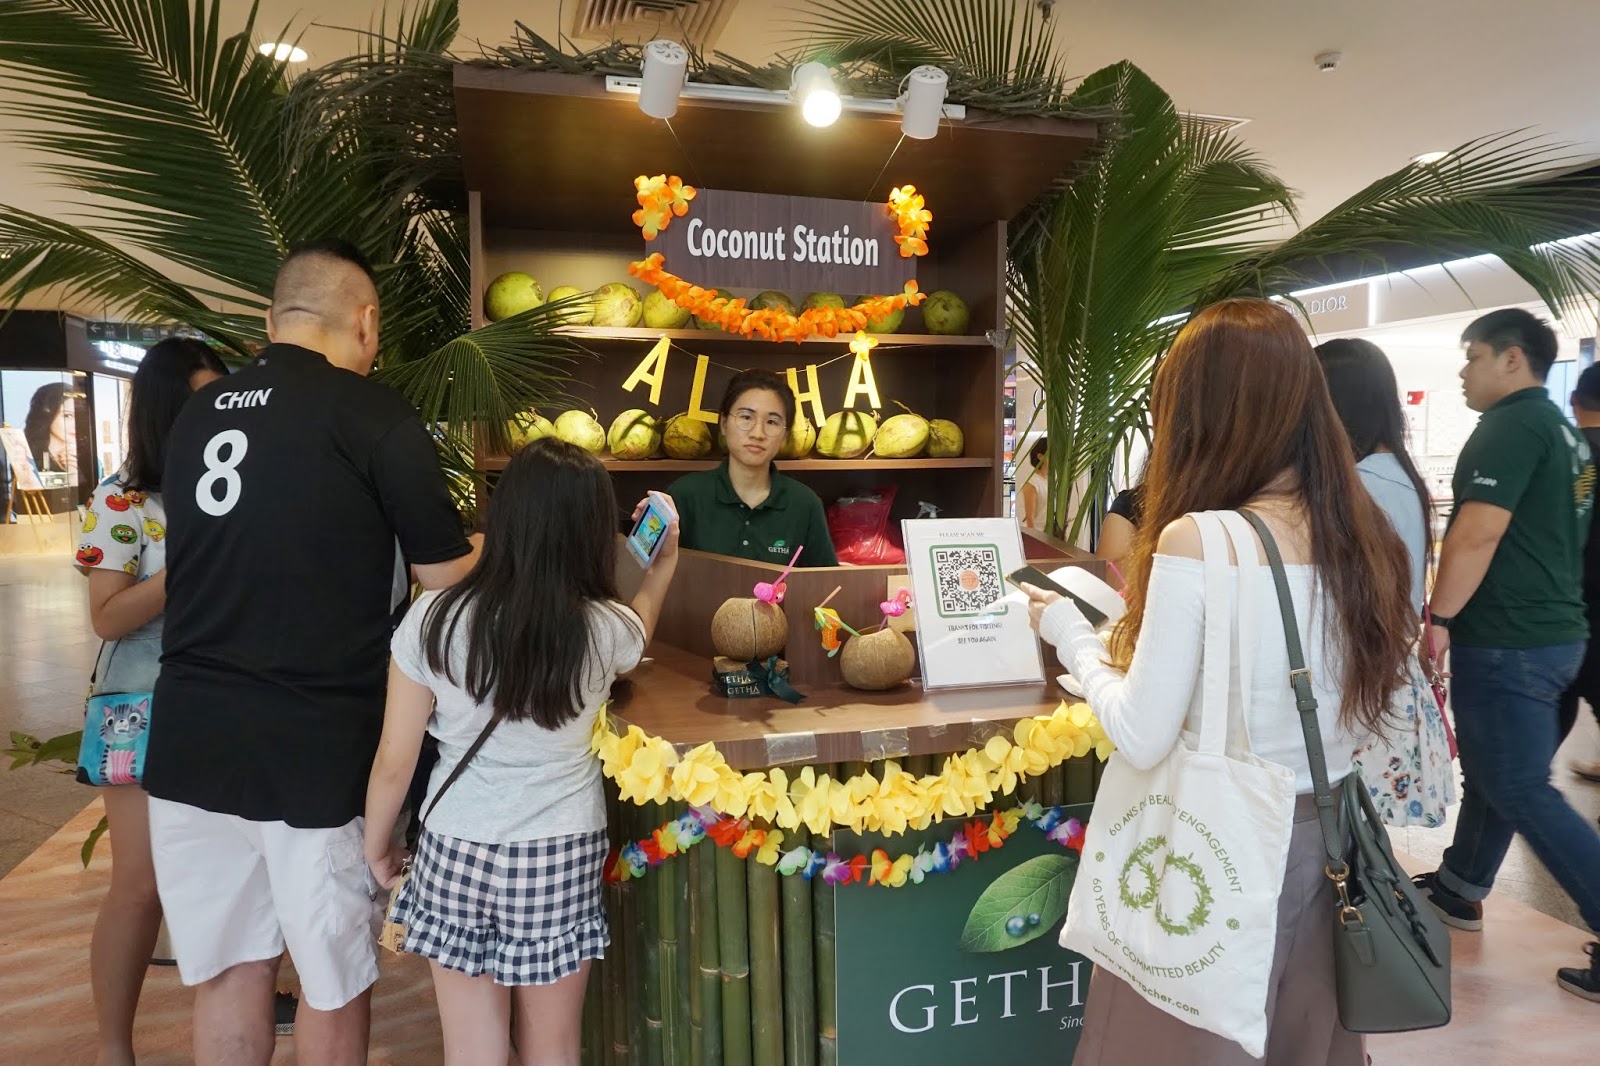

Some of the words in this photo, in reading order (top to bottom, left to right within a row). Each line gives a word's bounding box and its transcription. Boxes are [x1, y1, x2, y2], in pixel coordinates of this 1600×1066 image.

[687, 217, 786, 261] Coconut
[792, 224, 879, 267] Station
[1310, 295, 1348, 315] DIOR
[214, 387, 273, 410] CHIN
[621, 335, 882, 429] ALHA
[195, 429, 249, 517] 8
[1109, 822, 1122, 836] 60
[1122, 806, 1138, 826] ANS
[1149, 794, 1174, 806] BEAU
[1093, 878, 1102, 893] 60
[1094, 894, 1111, 931] YEARS
[1107, 931, 1122, 947] OF
[1122, 946, 1184, 979] COMMITTED
[1185, 941, 1226, 976] BEAUTY
[889, 961, 1084, 1033] GETH
